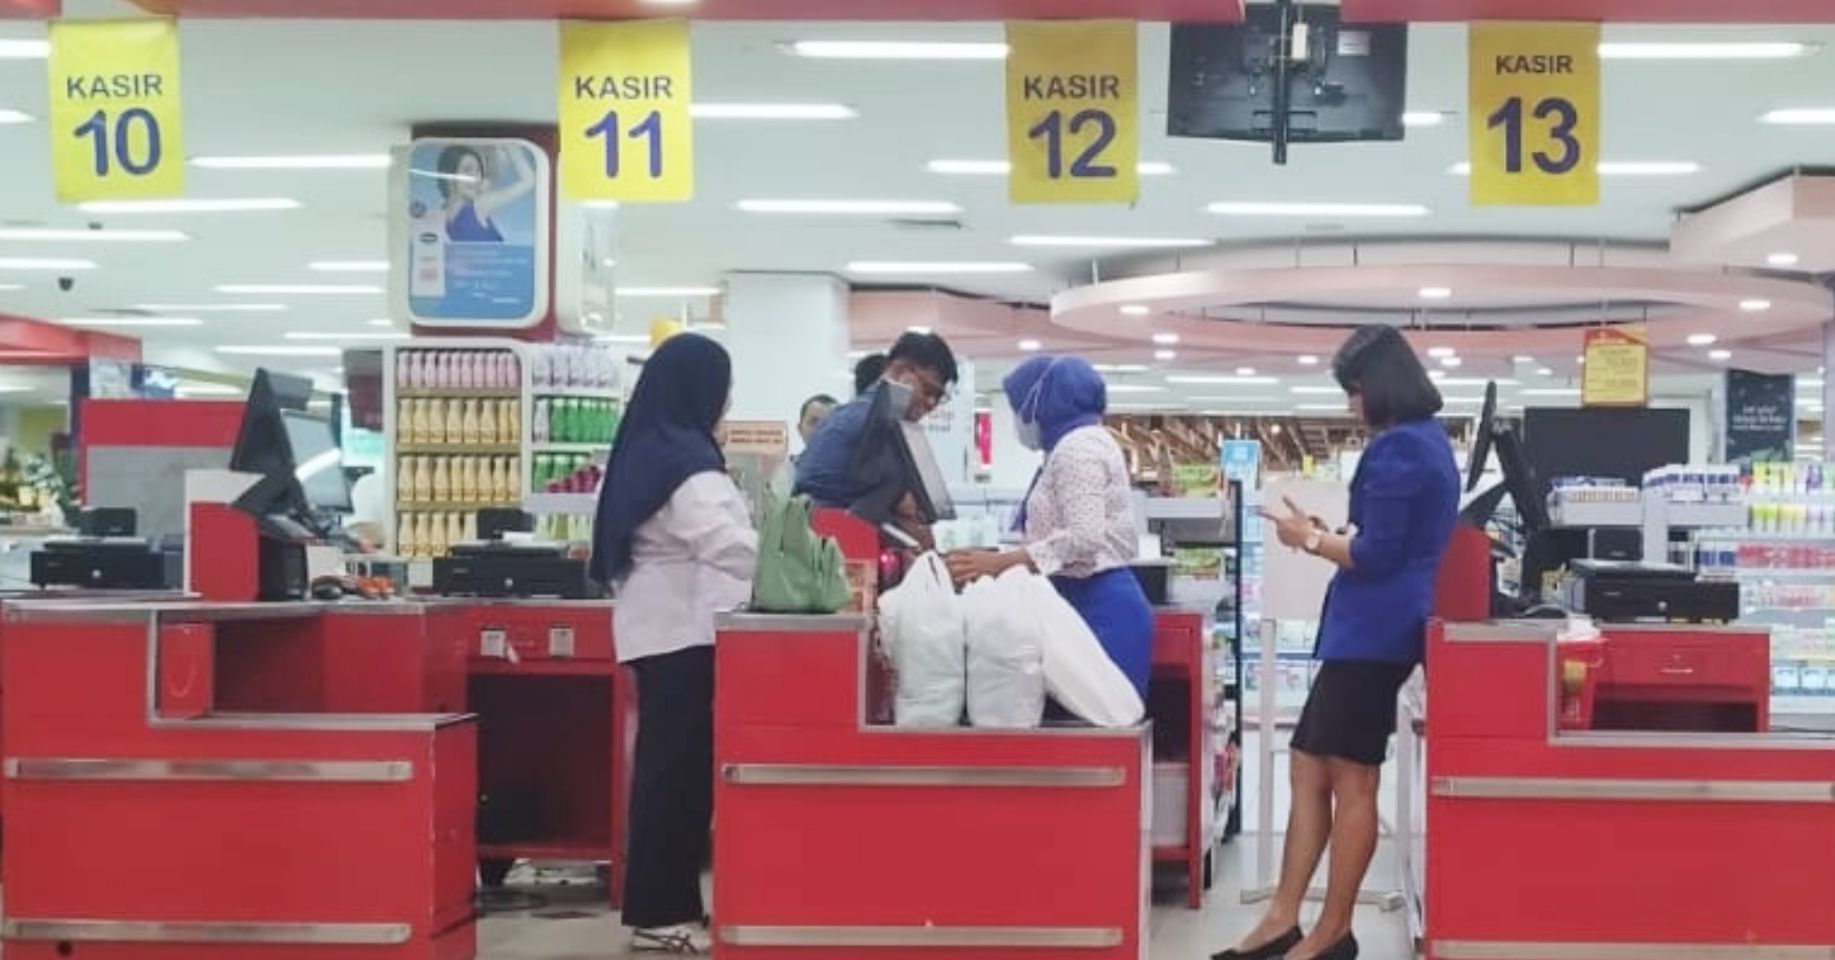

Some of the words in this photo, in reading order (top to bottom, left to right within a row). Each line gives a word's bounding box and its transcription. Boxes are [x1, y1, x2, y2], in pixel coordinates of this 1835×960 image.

[67, 74, 162, 97] KASIR
[575, 75, 674, 99] KASIR
[1023, 73, 1121, 101] KASIR
[1495, 54, 1575, 76] KASIR
[73, 108, 161, 177] 10
[584, 111, 662, 178] 11
[1027, 108, 1118, 179] 12
[1487, 95, 1581, 175] 13
